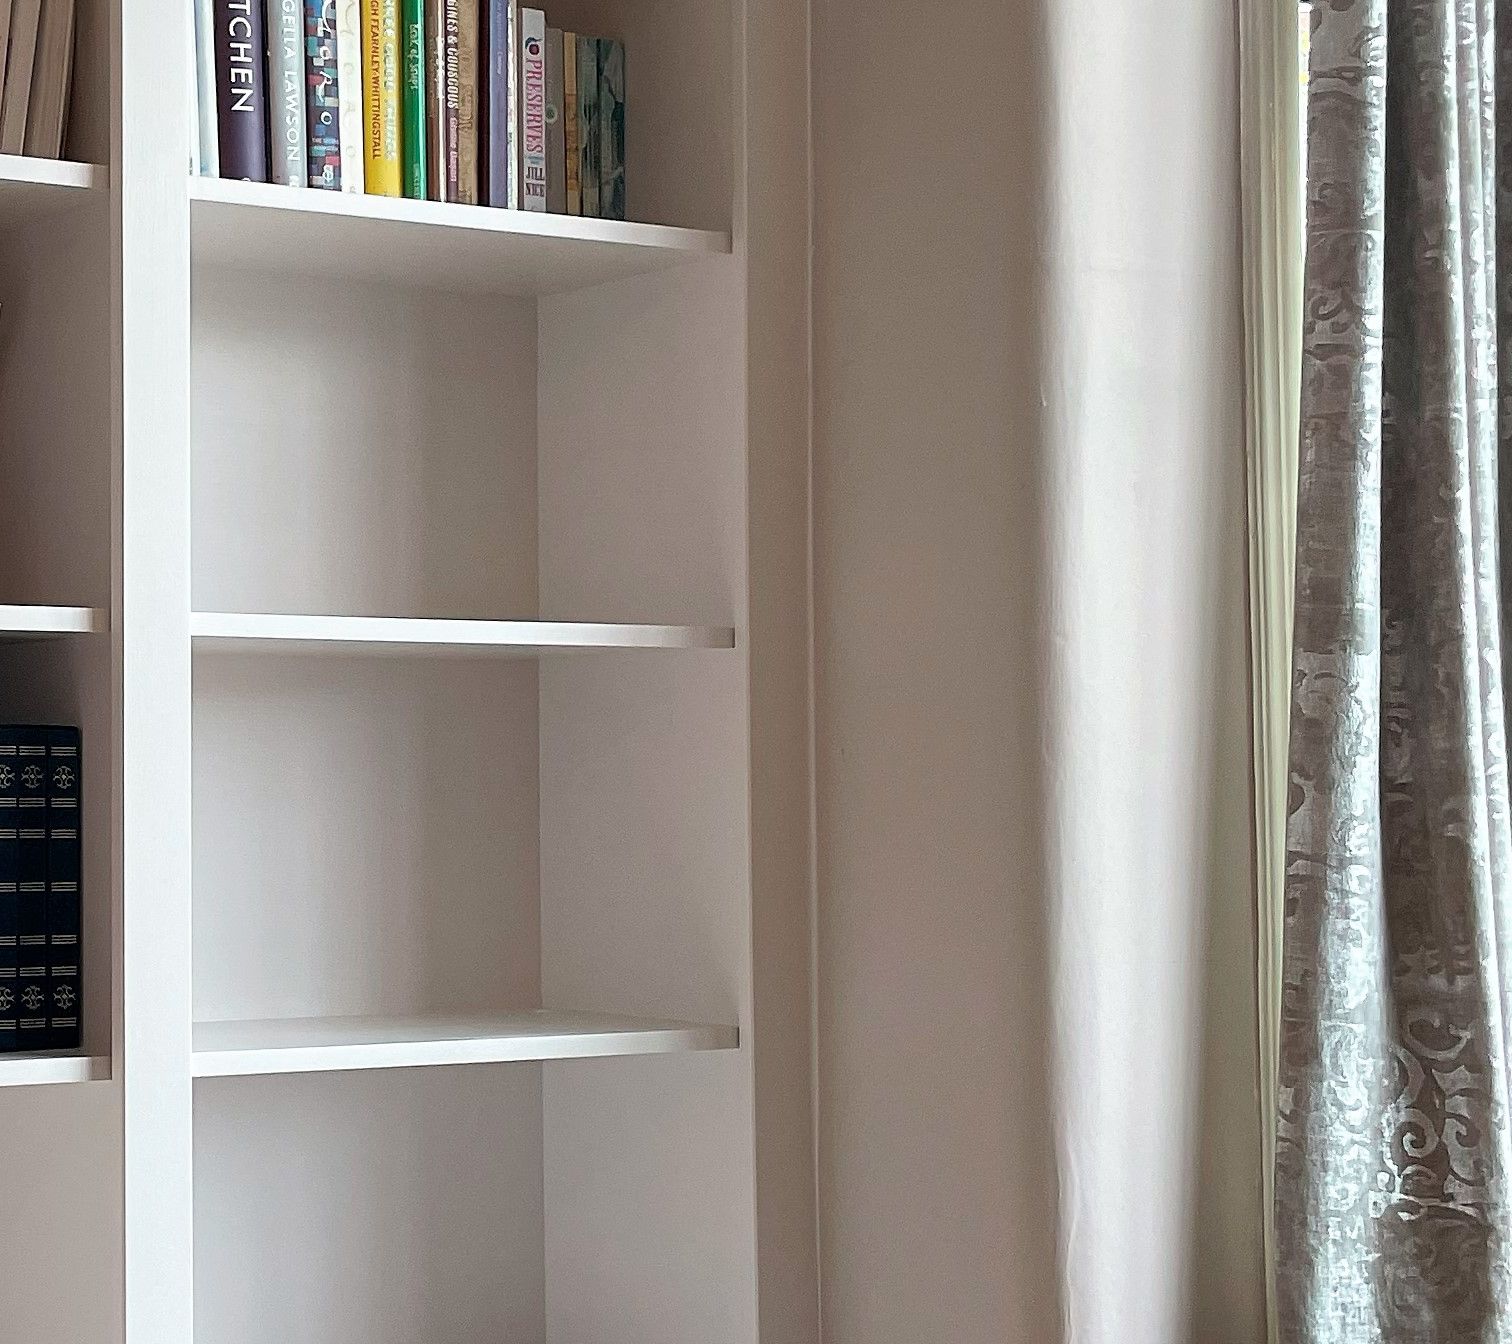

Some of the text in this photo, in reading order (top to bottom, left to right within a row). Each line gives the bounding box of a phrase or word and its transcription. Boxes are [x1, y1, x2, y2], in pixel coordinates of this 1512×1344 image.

[447, 35, 457, 44] &
[447, 48, 458, 109] COUSCOUS
[526, 57, 543, 153] PRESERVES
[283, 70, 300, 161] LAWSON
[526, 166, 545, 181] JILL
